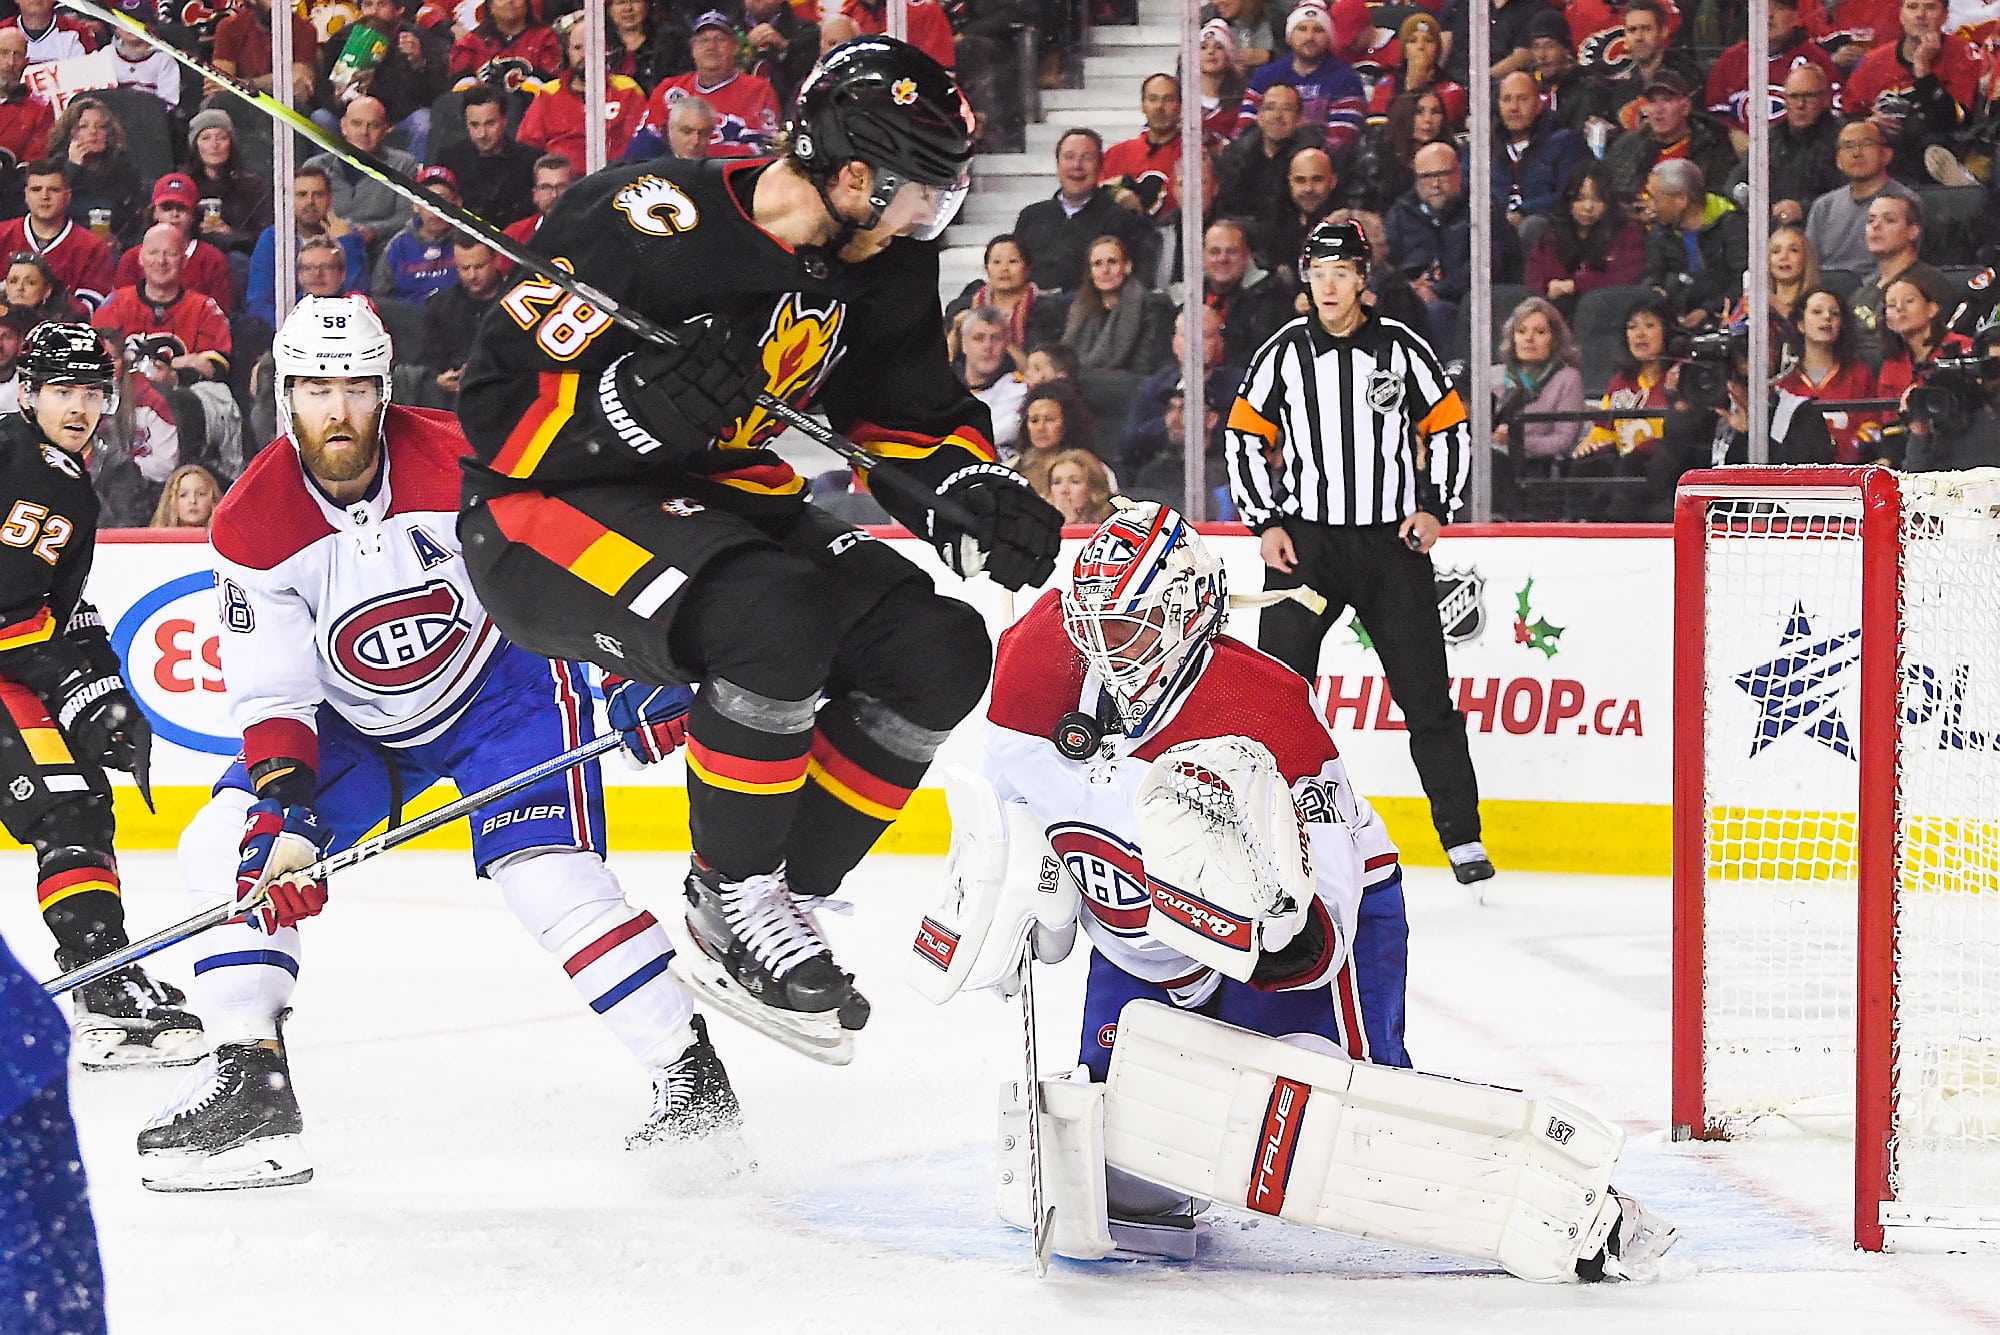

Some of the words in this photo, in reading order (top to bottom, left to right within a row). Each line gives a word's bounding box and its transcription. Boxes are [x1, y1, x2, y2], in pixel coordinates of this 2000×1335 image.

[323, 316, 346, 329] 58
[500, 256, 615, 362] 28
[67, 362, 101, 371] CCM
[0, 499, 74, 566] 52
[407, 525, 454, 570] A
[1315, 675, 1643, 737] HLHOP.CA
[481, 805, 566, 836] BAUER
[1038, 855, 1060, 893] L87
[918, 929, 951, 957] TRUE
[1255, 1083, 1295, 1204] TRUE
[1546, 1116, 1576, 1145] L87
